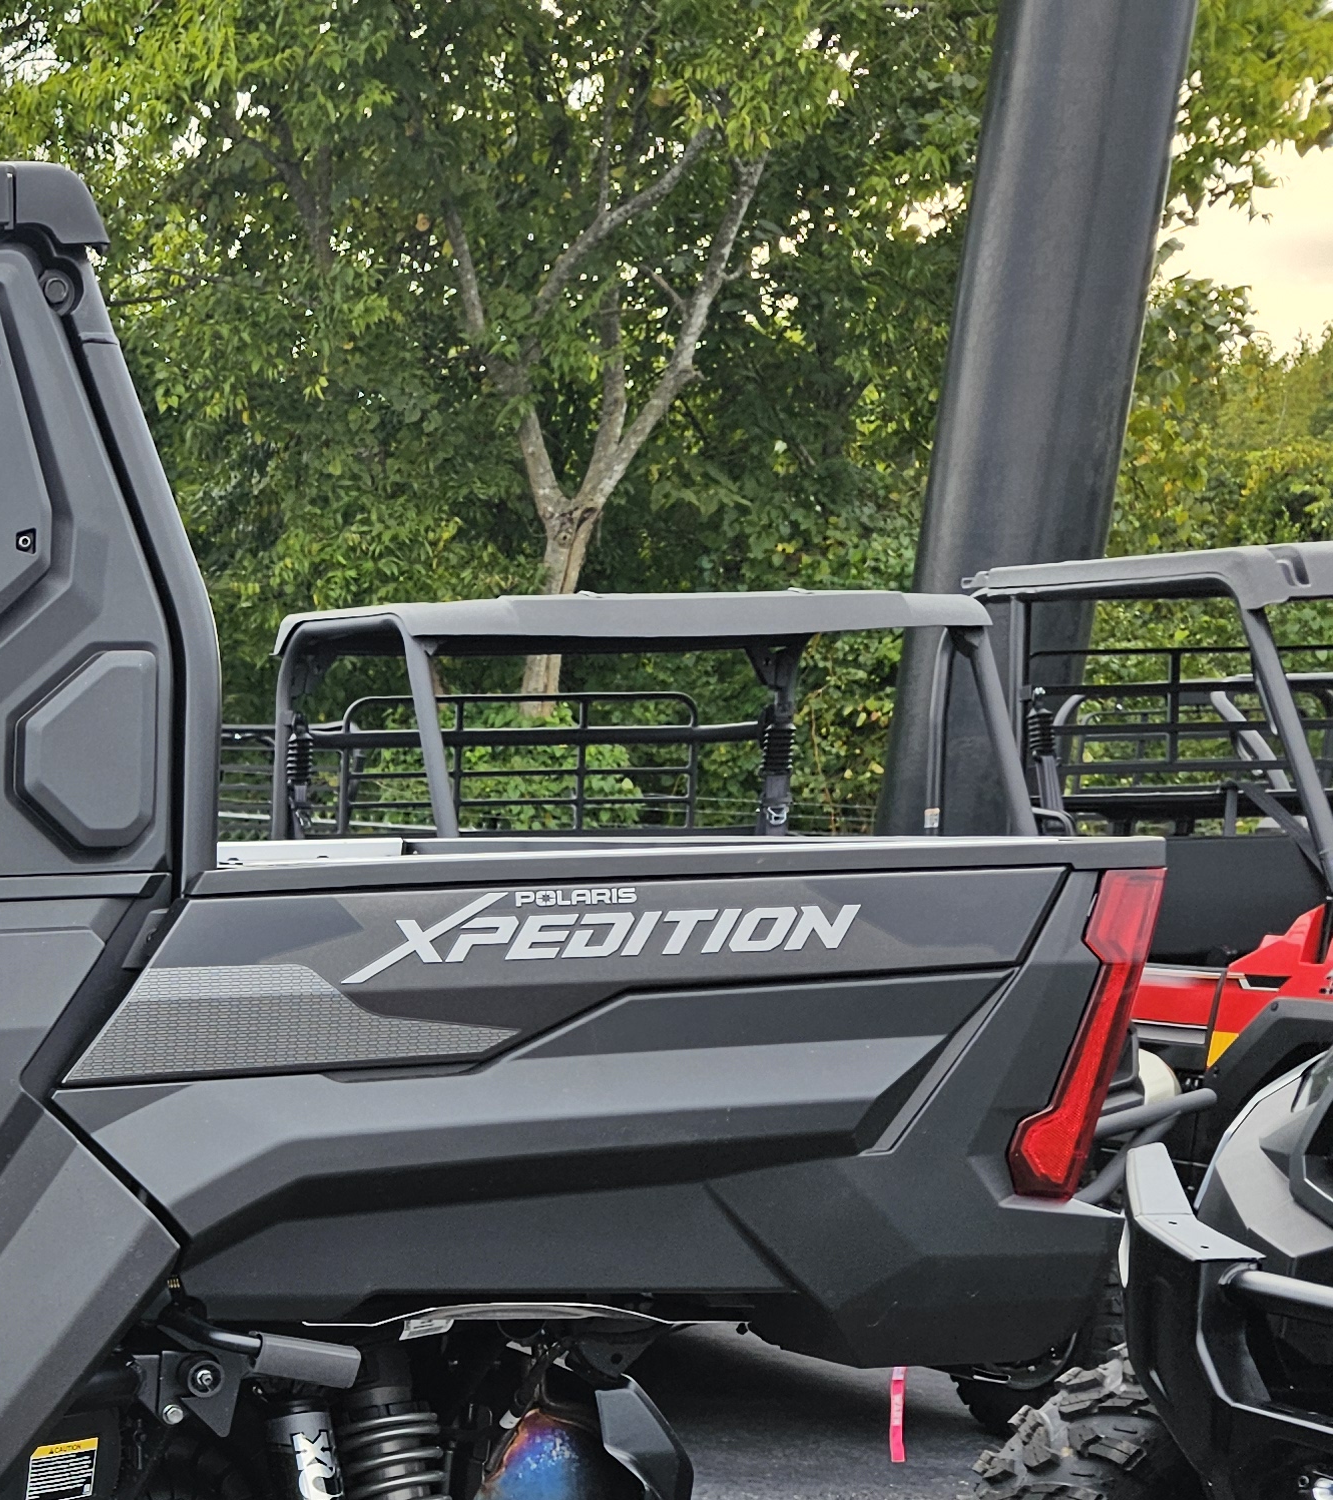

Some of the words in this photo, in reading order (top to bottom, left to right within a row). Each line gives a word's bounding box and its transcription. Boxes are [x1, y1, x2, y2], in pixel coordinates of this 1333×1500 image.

[515, 888, 638, 907] POLARIS
[341, 892, 861, 984] XPEDITION
[54, 1444, 82, 1454] CAUTION
